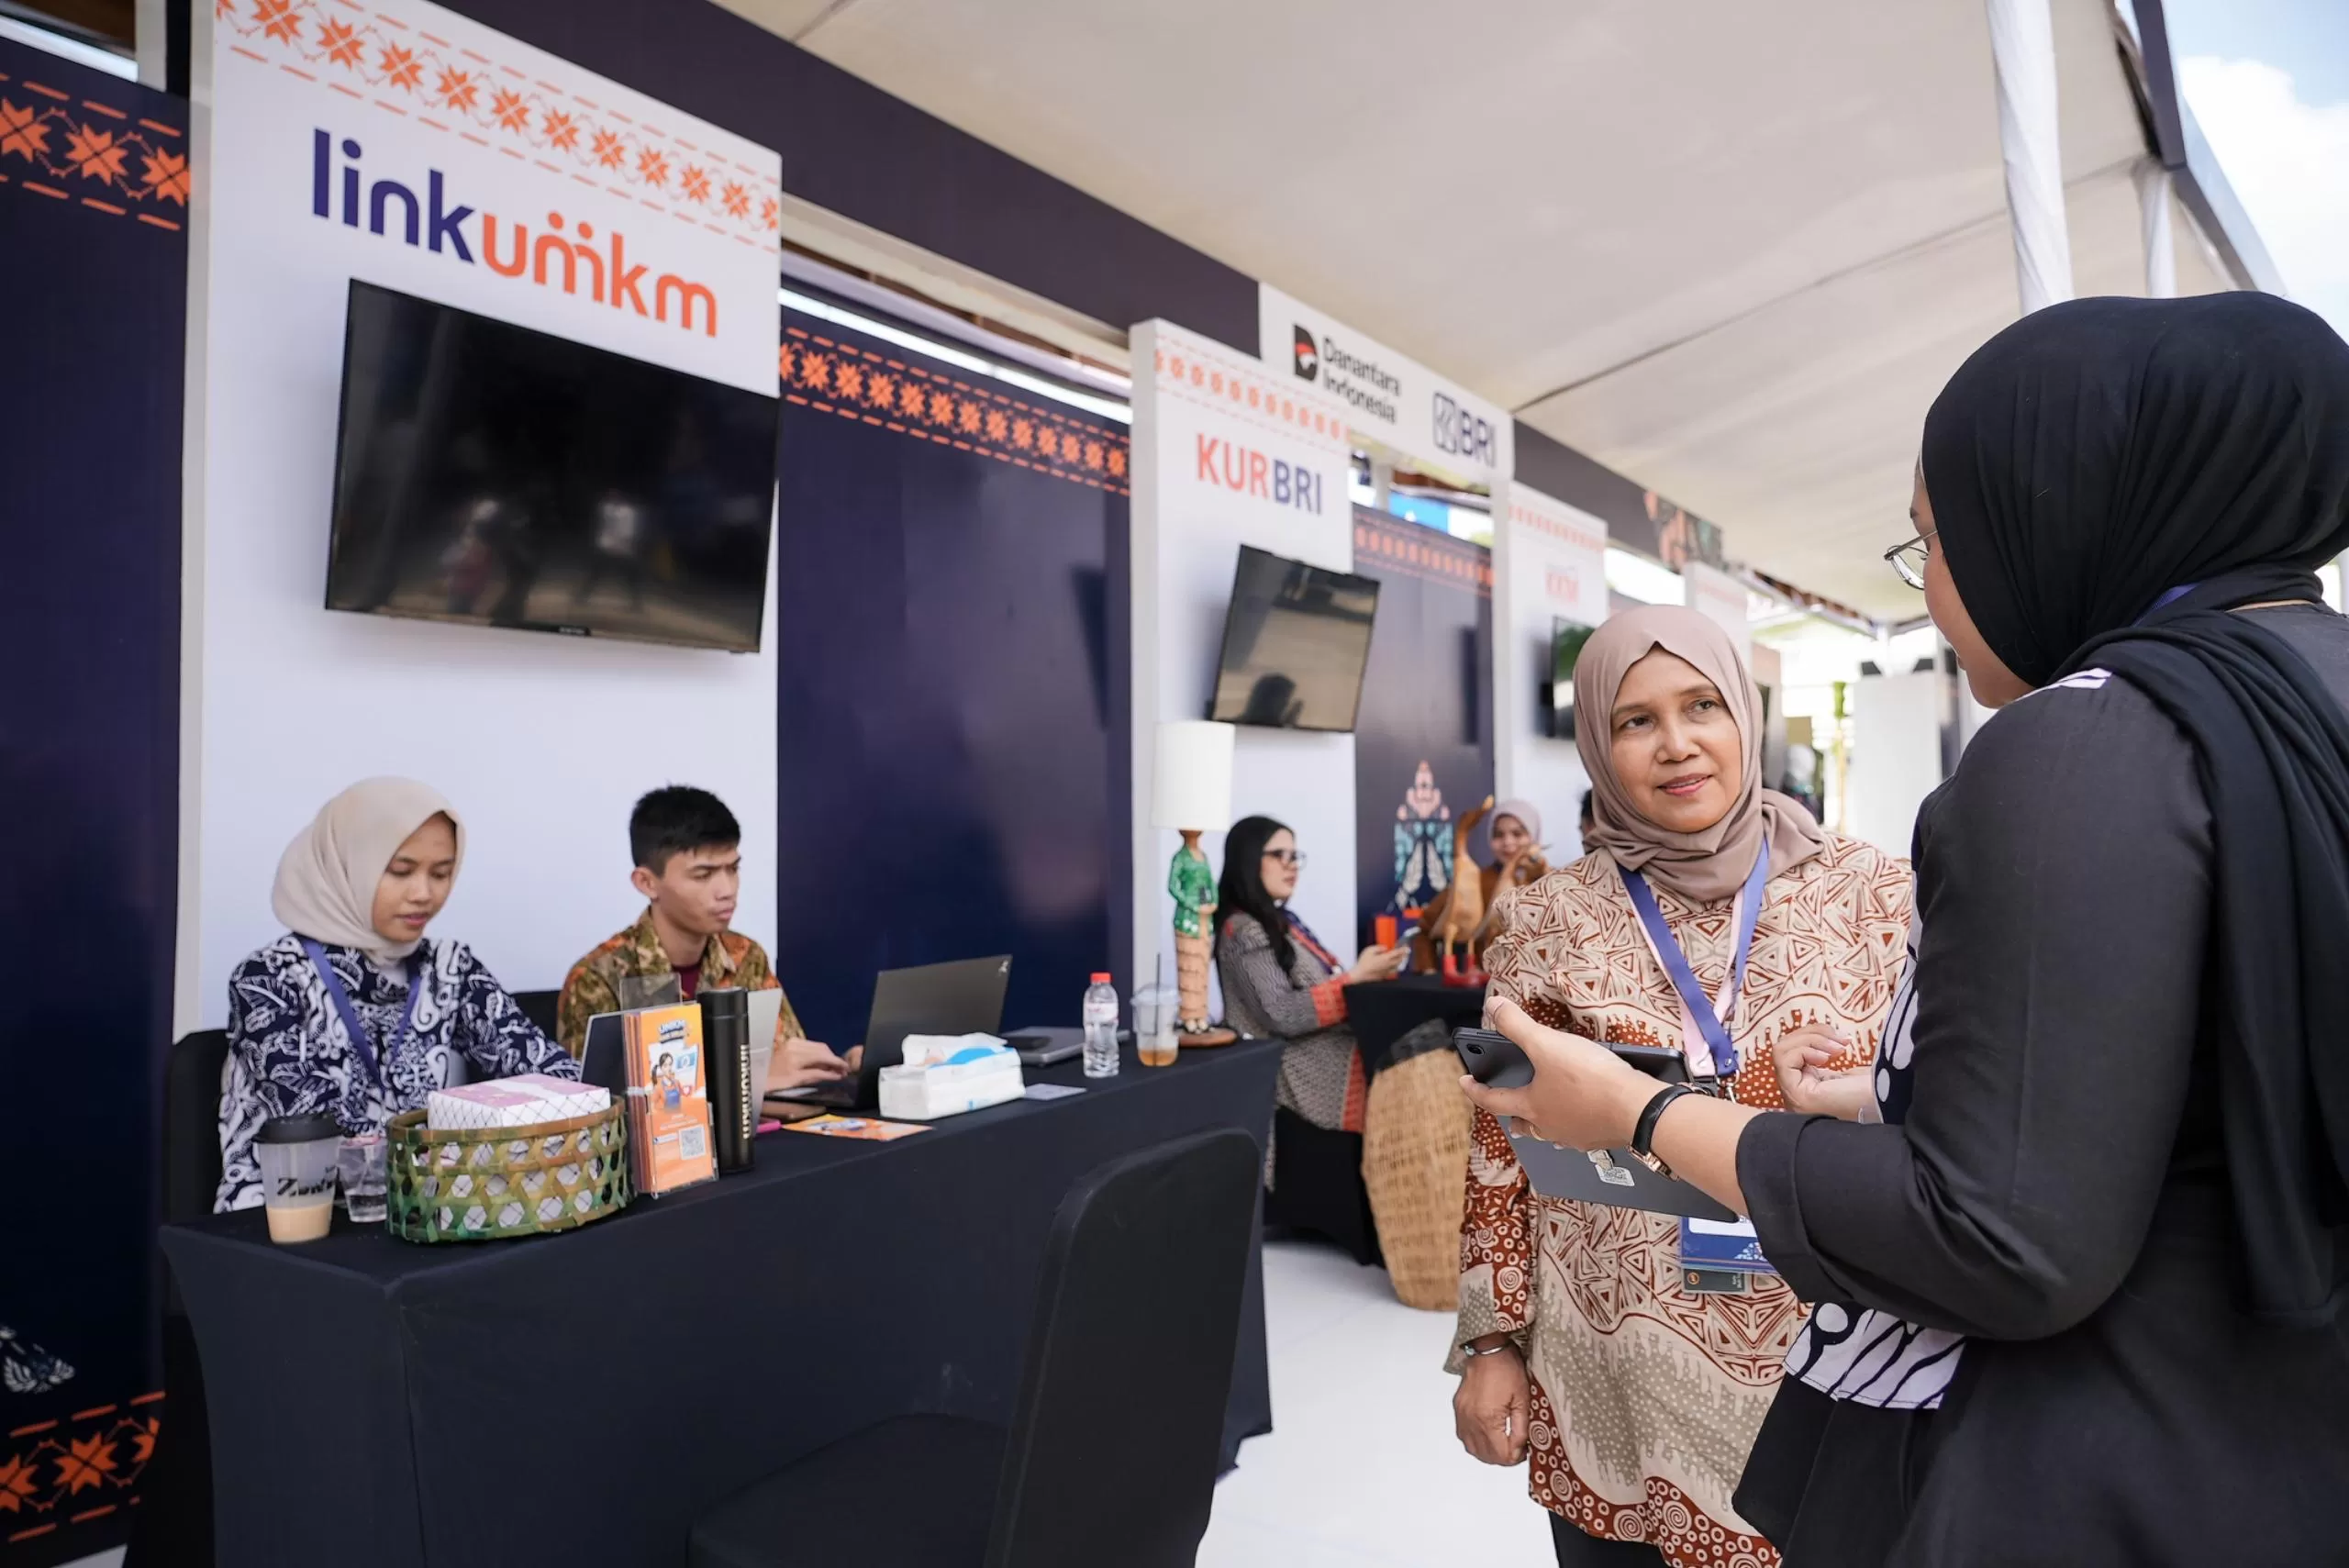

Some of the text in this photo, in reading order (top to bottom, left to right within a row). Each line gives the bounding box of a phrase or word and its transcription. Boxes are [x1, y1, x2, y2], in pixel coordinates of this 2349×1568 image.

[313, 128, 717, 338] linkumkm
[1323, 337, 1400, 396] Danantara
[1323, 370, 1396, 425] Indonesia
[1461, 409, 1496, 468] BRI
